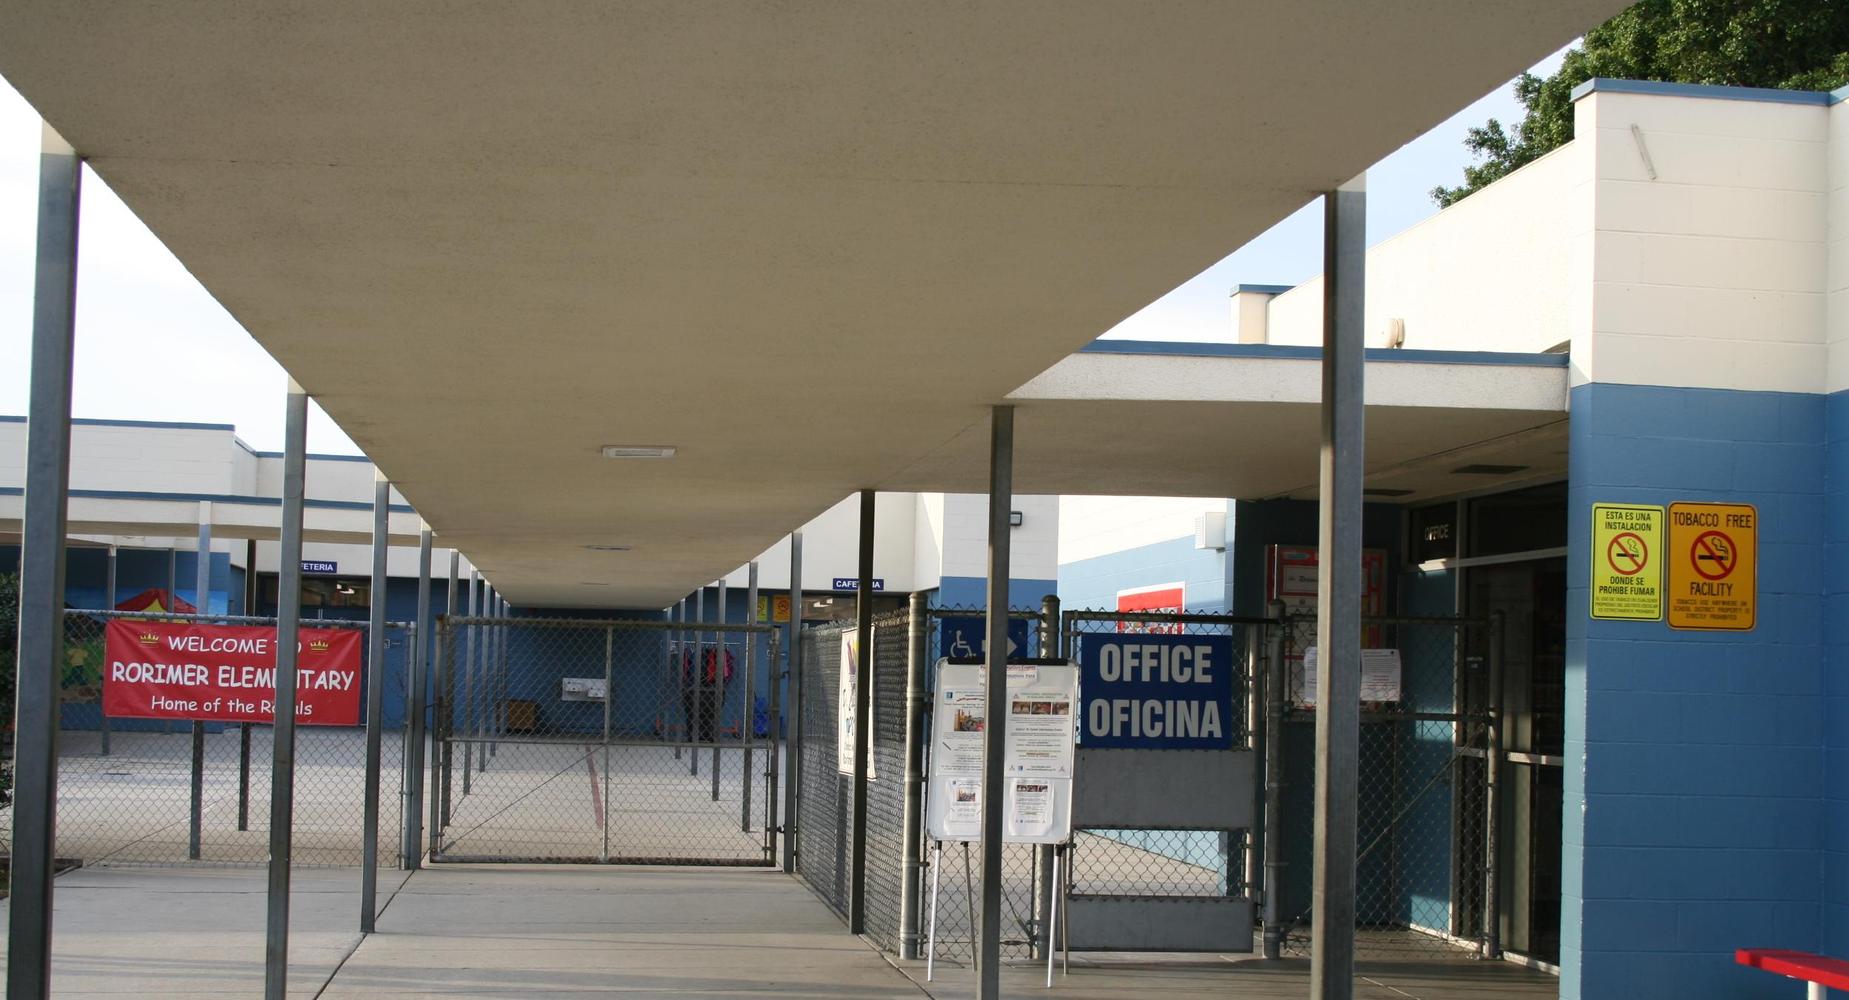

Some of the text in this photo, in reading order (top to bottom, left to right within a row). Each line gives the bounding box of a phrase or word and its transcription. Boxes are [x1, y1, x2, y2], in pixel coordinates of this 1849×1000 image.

[1605, 511, 1652, 522] ESTA ES UNA
[1673, 511, 1753, 529] TOBACCO FREE
[1604, 521, 1652, 532] INSTALACION
[301, 562, 334, 571] ETERIA
[836, 580, 881, 588] CAFEIA
[1610, 575, 1645, 586] DONDE SE
[1599, 585, 1656, 597] PROHIBE FUMAR
[1690, 581, 1734, 597] FACILITY
[167, 635, 267, 655] WELCOME
[1100, 643, 1213, 683] OFFICE
[112, 661, 355, 691] RORIMER ELEMTARY
[151, 695, 198, 712] Home
[203, 697, 222, 712] of
[227, 698, 255, 713] the
[1089, 698, 1222, 738] OFICINA
